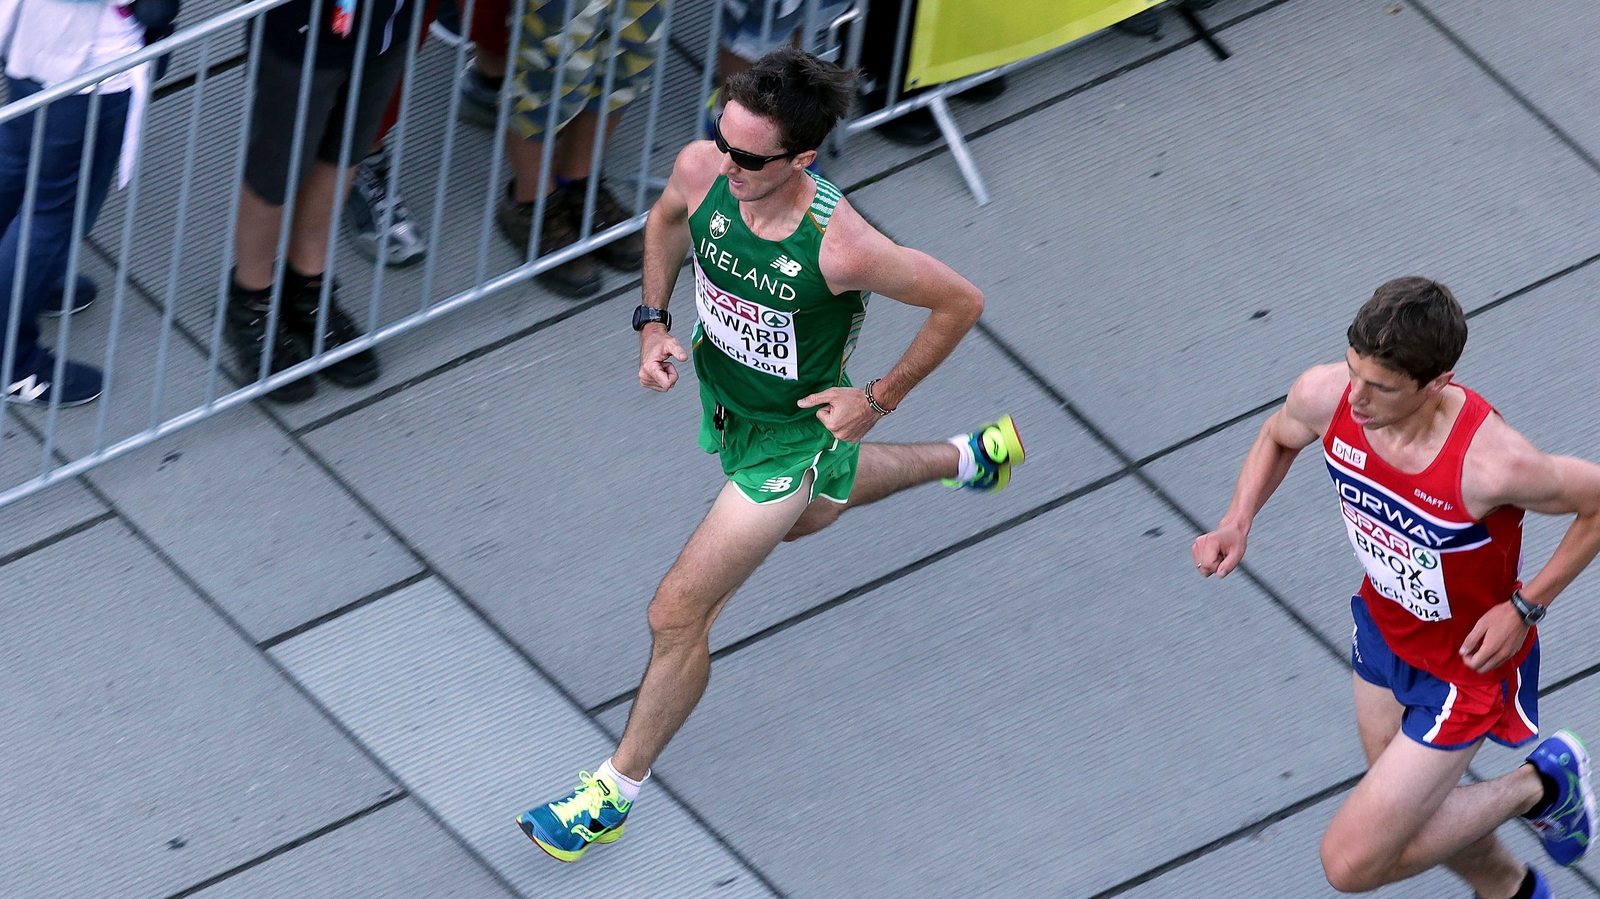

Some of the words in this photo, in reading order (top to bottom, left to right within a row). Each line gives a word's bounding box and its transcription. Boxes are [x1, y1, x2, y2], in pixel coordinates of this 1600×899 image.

[700, 238, 797, 301] IRELAND
[741, 337, 789, 359] 140
[751, 357, 788, 376] 2014
[1335, 443, 1361, 464] DNB
[1342, 501, 1409, 557] SPAR
[1354, 530, 1424, 587] BROX
[1395, 574, 1440, 605] 156
[1407, 599, 1440, 618] 2014
